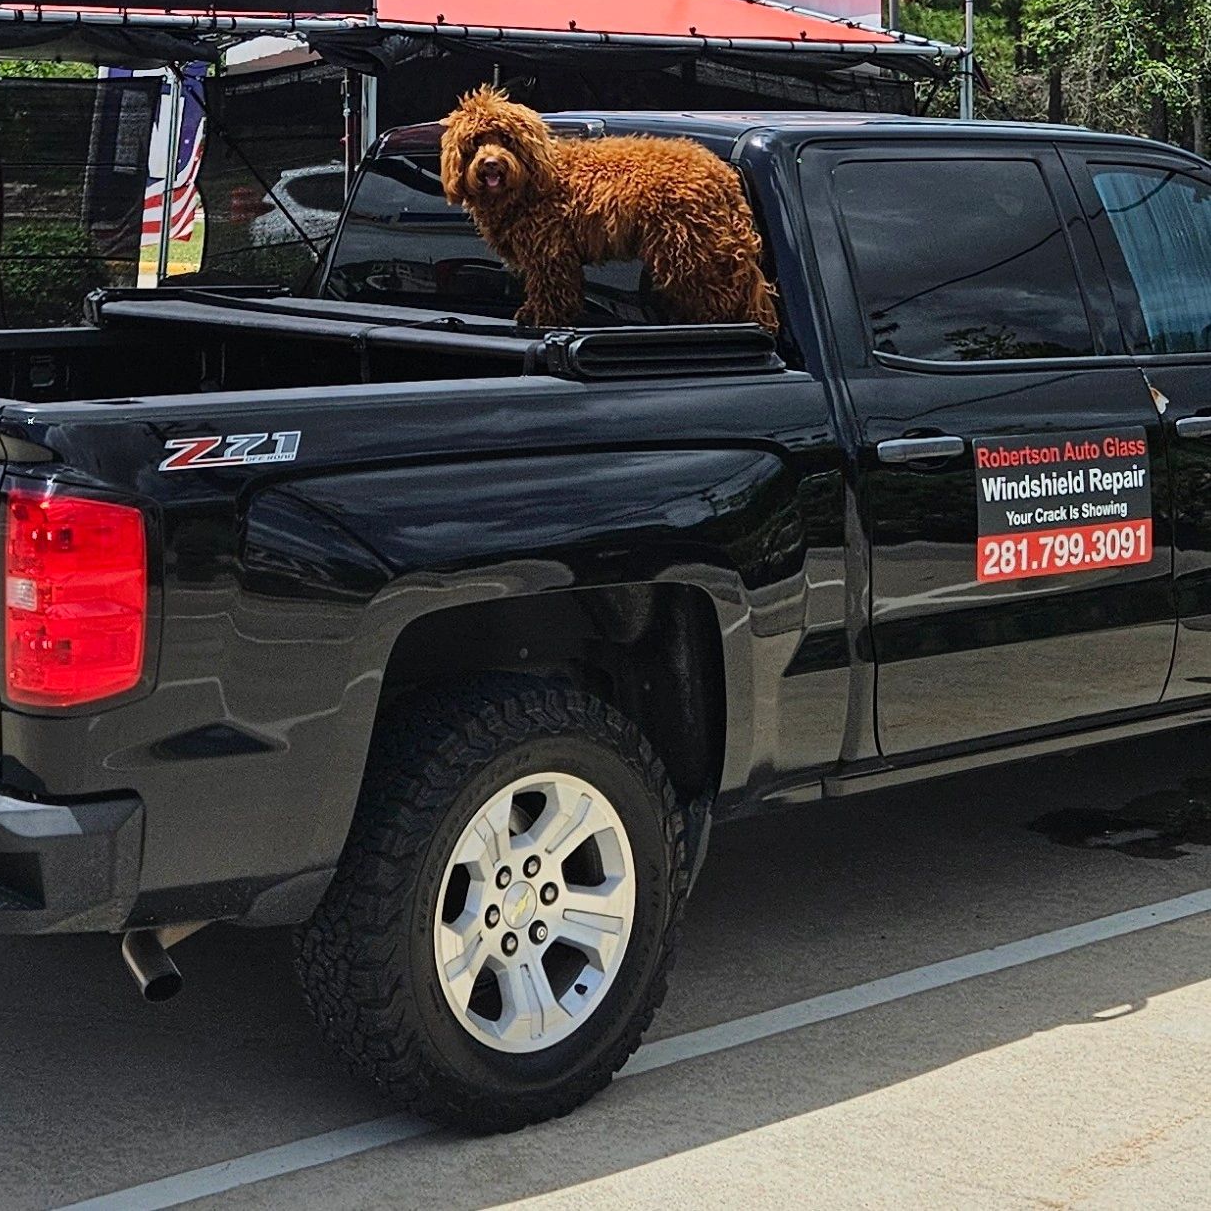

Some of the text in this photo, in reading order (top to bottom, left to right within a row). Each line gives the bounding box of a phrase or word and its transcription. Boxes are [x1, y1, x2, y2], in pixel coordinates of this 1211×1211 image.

[158, 430, 302, 472] Z71
[977, 437, 1146, 469] Robertson Auto Glass
[981, 464, 1146, 502] Windshield Repair
[1006, 500, 1128, 526] Your Crack Is Showing
[983, 524, 1147, 576] 281.799.3091
